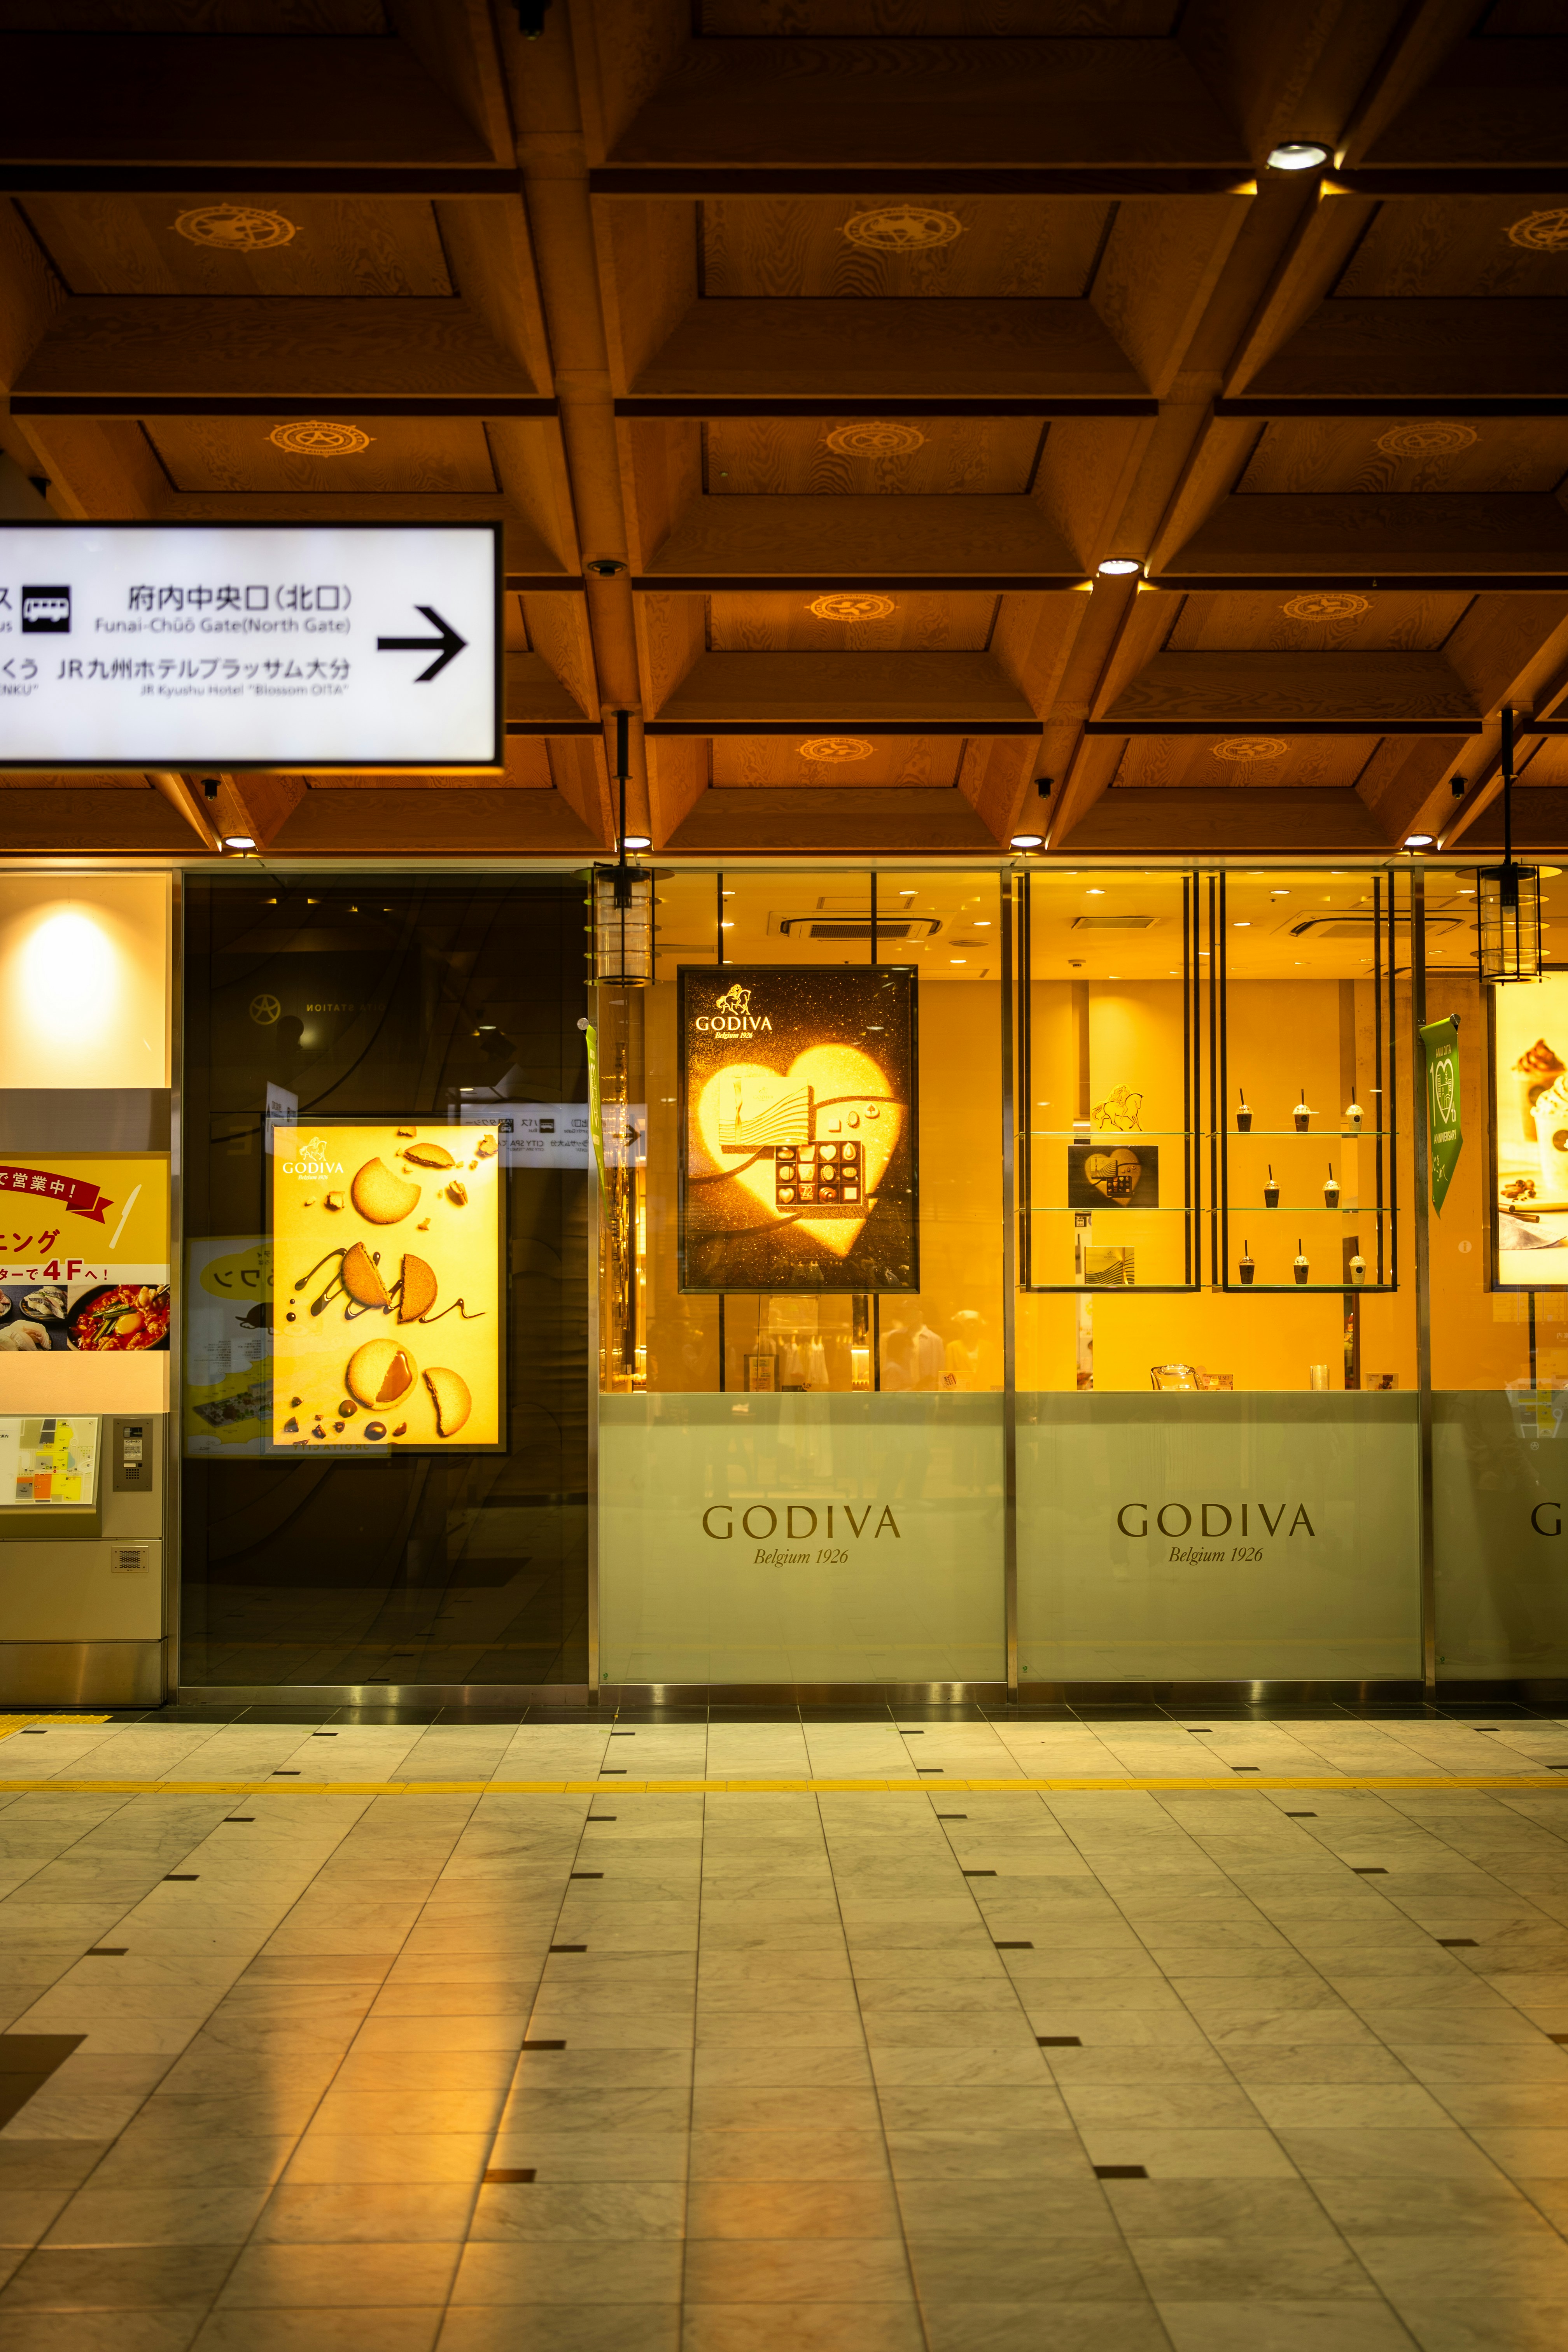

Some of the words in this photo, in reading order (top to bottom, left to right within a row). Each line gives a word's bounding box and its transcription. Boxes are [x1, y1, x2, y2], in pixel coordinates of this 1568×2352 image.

[129, 584, 352, 611] 府内中央口(北口)
[201, 617, 299, 635] Gate(North
[304, 617, 351, 635] Gate)
[57, 658, 351, 680] JR九州ホテルブラッサム大分
[140, 684, 154, 695] JR
[159, 683, 205, 698] Kyushu
[209, 683, 243, 696] Hotel
[695, 1016, 772, 1031] GODIVA
[1434, 1129, 1456, 1144] ANNIVERSARY
[282, 1162, 344, 1174] GODIVA
[702, 1504, 901, 1540] GODIVA
[1117, 1503, 1315, 1538] GODIVA
[1531, 1502, 1562, 1536] G
[753, 1549, 810, 1568] Belgium
[815, 1549, 849, 1564] 1926
[1168, 1546, 1225, 1566] Belgium
[1229, 1547, 1264, 1562] 1926
